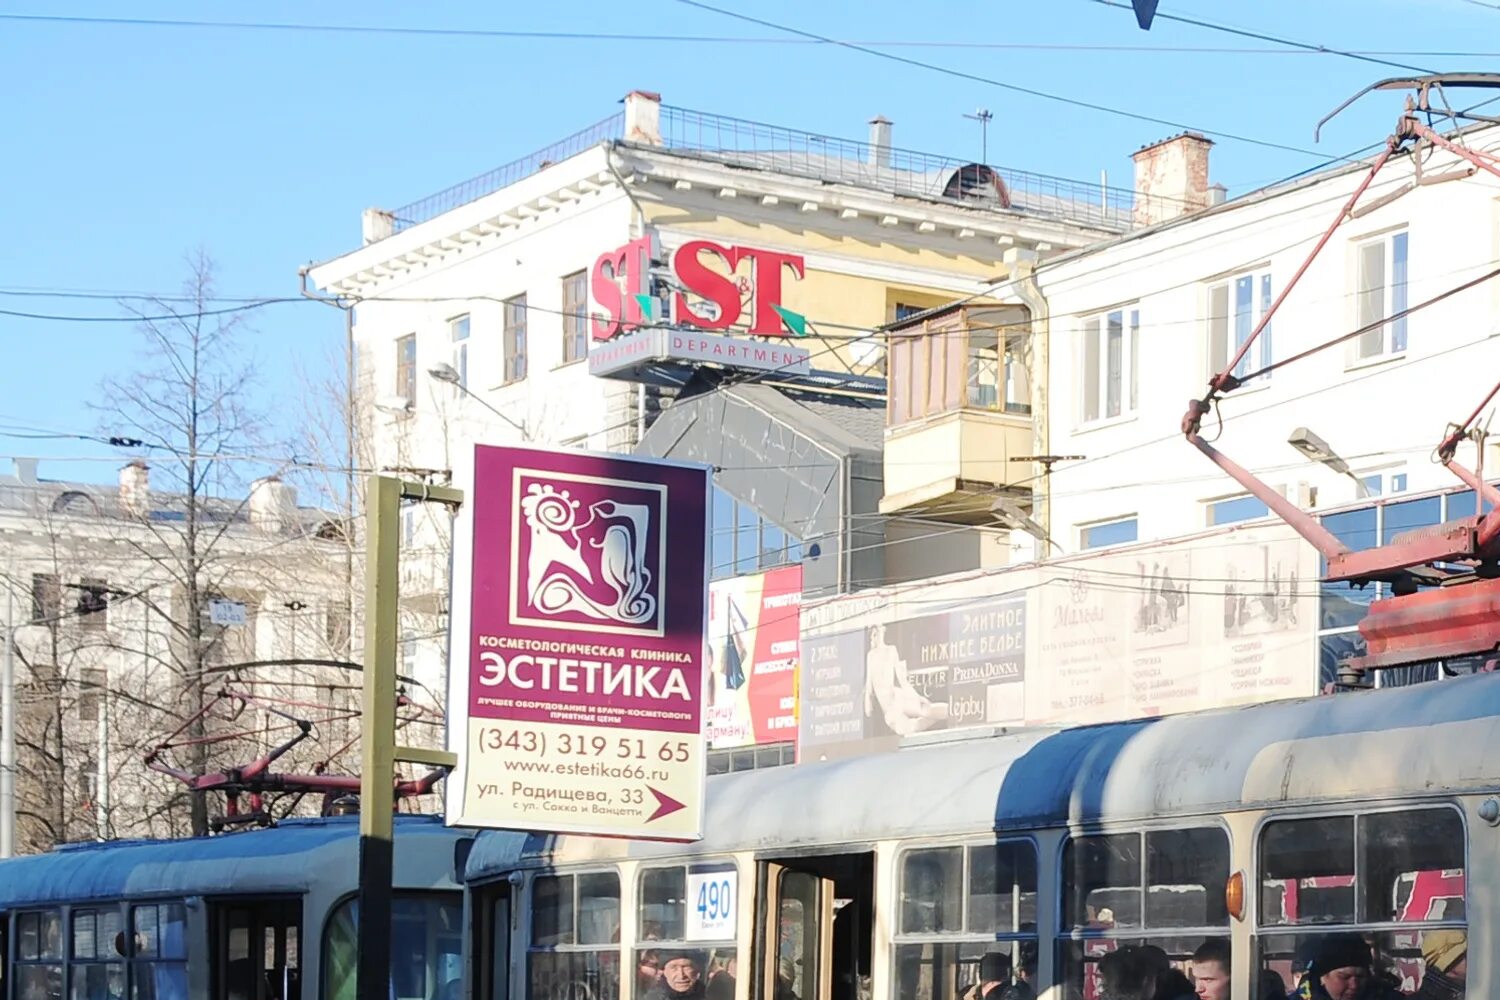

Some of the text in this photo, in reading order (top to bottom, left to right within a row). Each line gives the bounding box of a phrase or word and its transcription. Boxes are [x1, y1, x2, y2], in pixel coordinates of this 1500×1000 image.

[672, 337, 806, 367] DEPARTMENT
[962, 608, 1023, 634] ЭЛИТНОЕ
[479, 635, 692, 664] КОСМЕТОЛОГИЧЕСКАЯ КЛИНИКА
[921, 639, 975, 664] НИЖНЕЕ
[980, 632, 1022, 654] БЕЛЬЕ
[479, 651, 692, 701] ЭСТЕТИКА
[477, 696, 692, 721] ЛУЧШЕЕ ОБОРУДОВАНИЕ И ВРАЧИ-КОСМЕТОЛОГИ
[550, 712, 622, 724] ПРИЯТНЫЕ ЦЕНЫ
[479, 727, 690, 763] (343) 319 51 65
[504, 759, 669, 781] www.estetika66.ru
[476, 781, 644, 805] ул. Радищева, 33
[522, 802, 539, 811] ул.
[697, 880, 731, 920] 490
